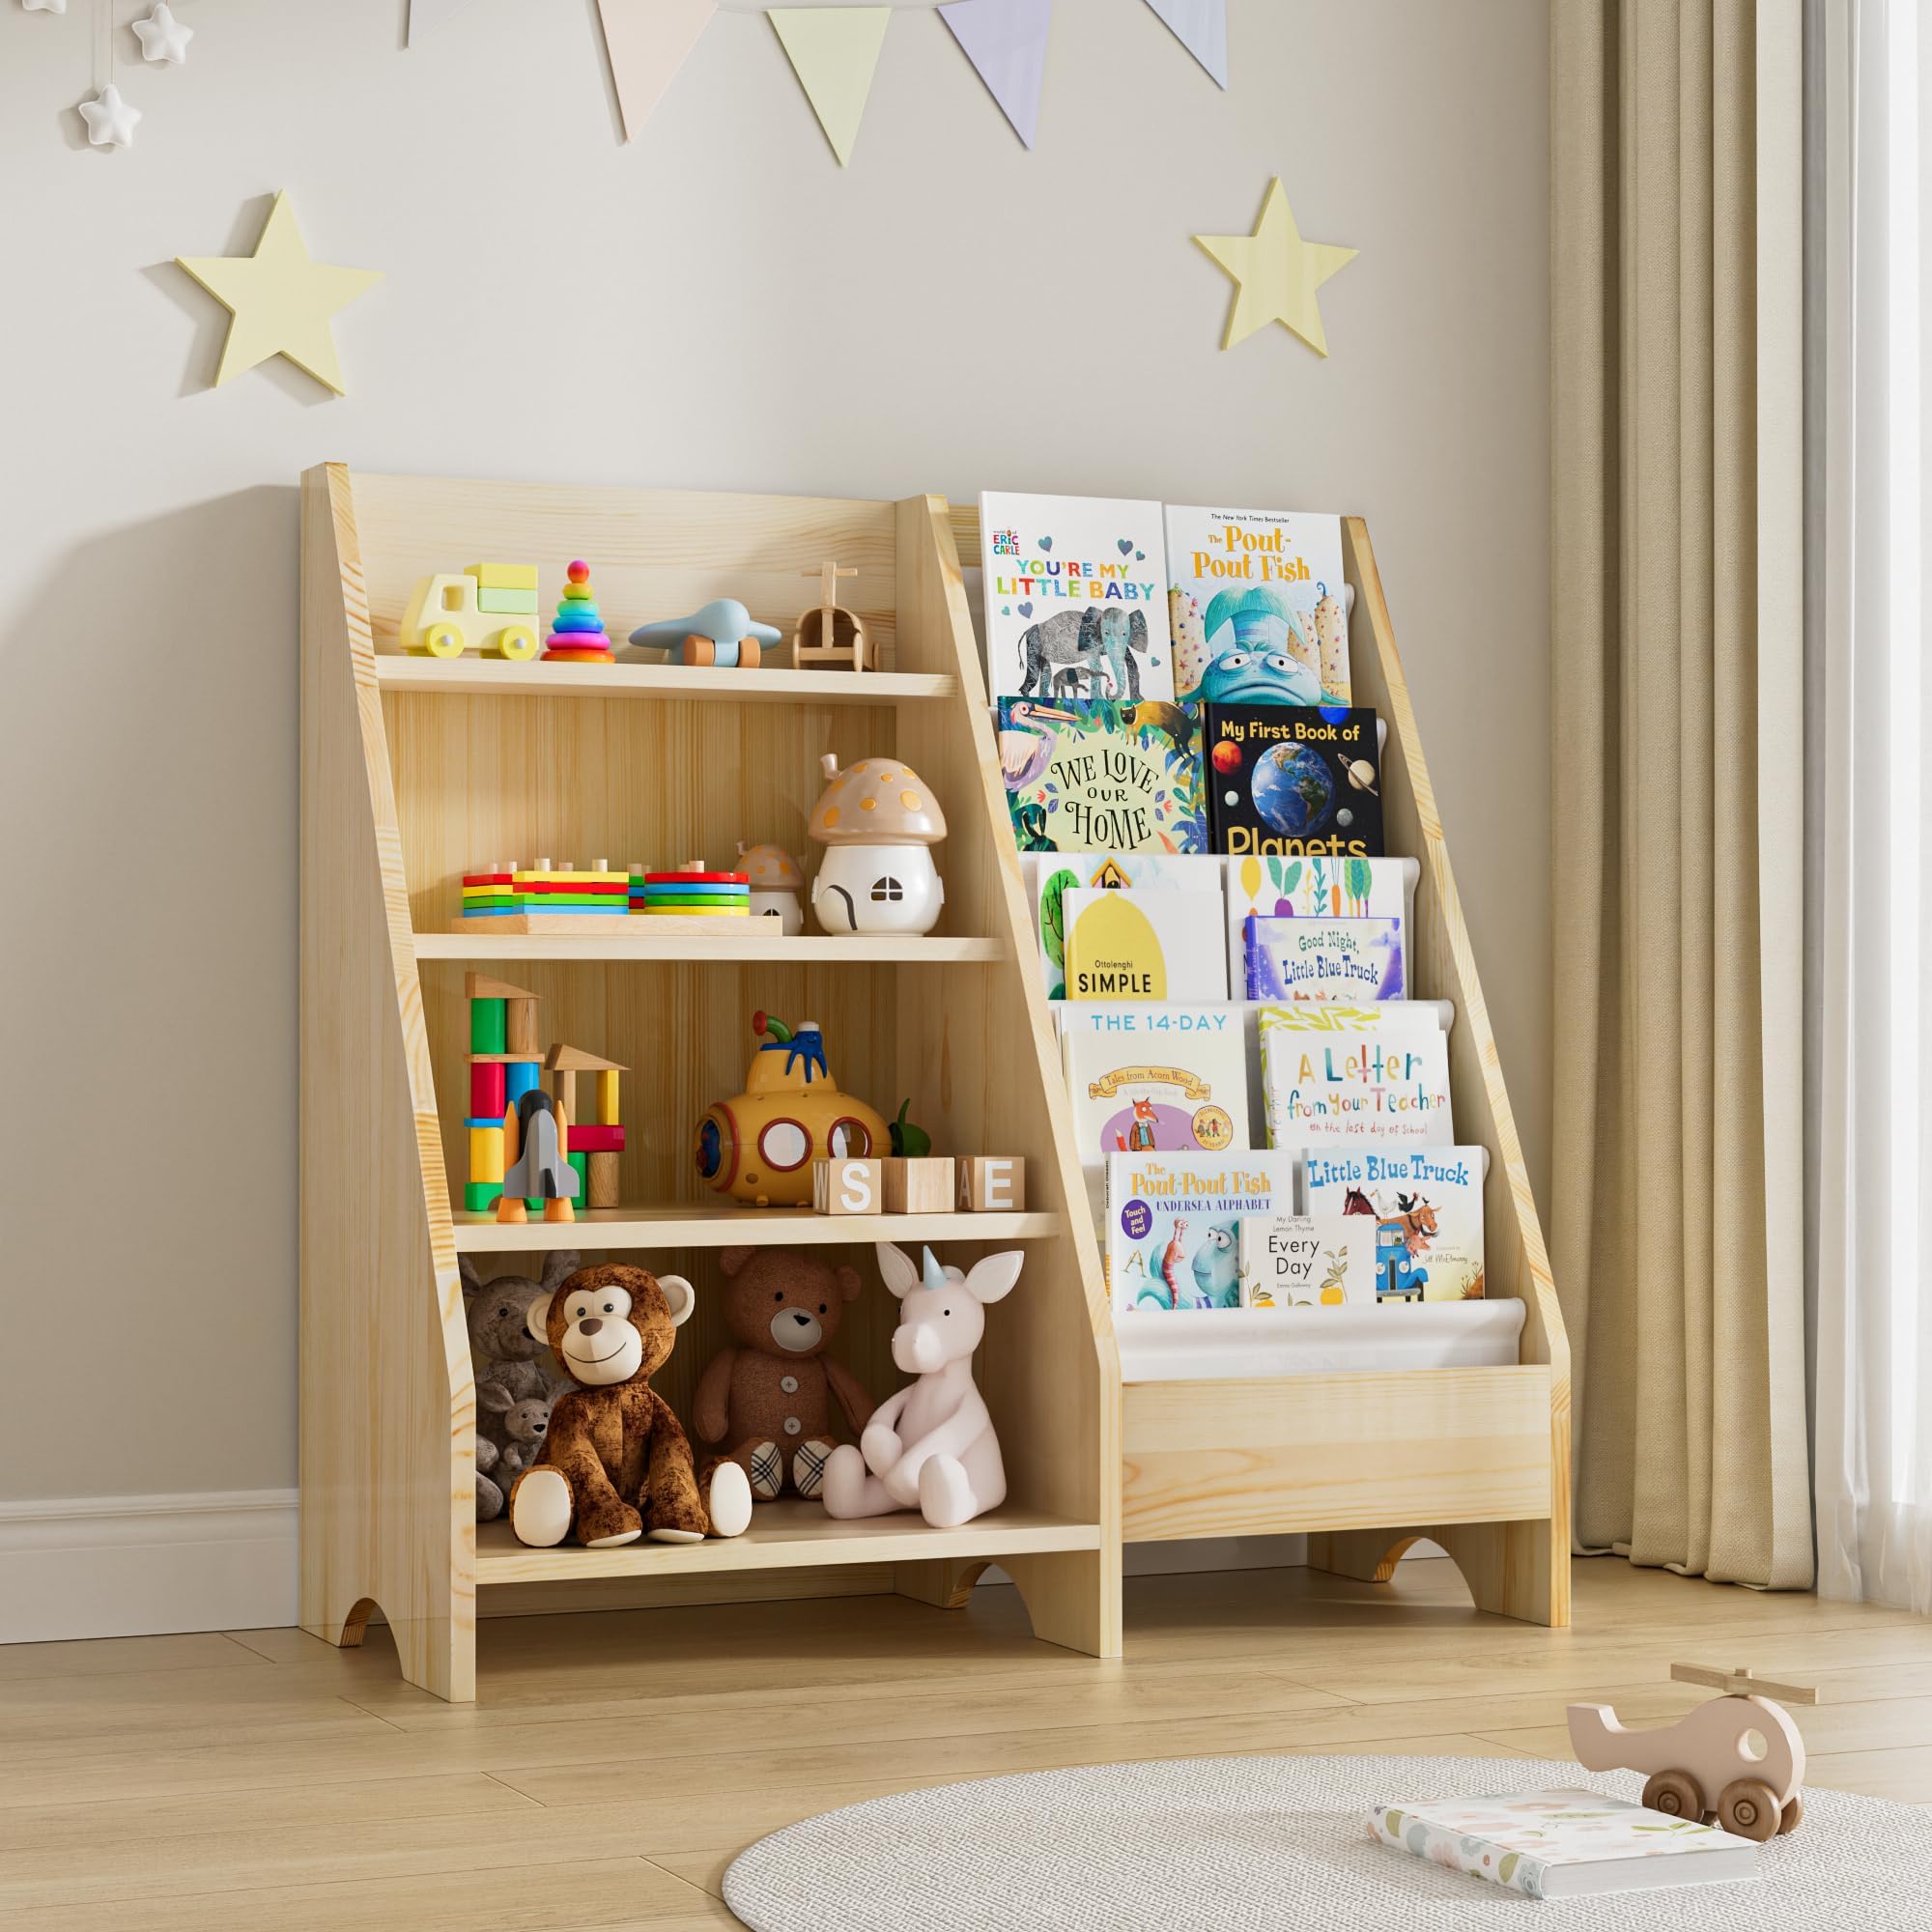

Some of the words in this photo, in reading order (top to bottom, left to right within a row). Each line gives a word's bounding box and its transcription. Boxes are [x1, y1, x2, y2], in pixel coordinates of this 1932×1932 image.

[993, 545, 1020, 555] CARLE
[1208, 534, 1222, 544] The
[1223, 526, 1291, 553] Pout-
[1016, 559, 1094, 578] YOU'RE
[1099, 563, 1128, 579] MY
[1190, 551, 1254, 579] Pout
[1258, 554, 1311, 582] Fish
[997, 577, 1081, 597] LITTLE
[1090, 581, 1155, 601] BABY
[1221, 720, 1244, 742] My
[1249, 722, 1291, 739] First
[1294, 723, 1337, 741] Book
[1342, 724, 1360, 741] of
[1051, 755, 1096, 790] WE
[1101, 750, 1159, 794] LOVE
[1088, 787, 1128, 802] OUR
[1065, 802, 1151, 850] HOME
[1227, 826, 1368, 857] Planets
[1298, 931, 1323, 952] Good
[1327, 931, 1360, 954] Night,
[1094, 960, 1133, 970] Ottolenghi
[1283, 959, 1314, 985] Little
[1316, 954, 1341, 979] Blue
[1343, 954, 1378, 985] Truck
[1078, 974, 1151, 993] SIMPLE
[1091, 1014, 1136, 1031] THE
[1147, 1014, 1227, 1031] 14-DAY
[1298, 1053, 1316, 1084] A
[1325, 1044, 1422, 1083] Letter
[1105, 1073, 1124, 1086] Tales
[1126, 1071, 1144, 1081] from
[1148, 1069, 1169, 1080] Acorn
[1172, 1070, 1194, 1087] Wood
[1287, 1090, 1326, 1120] from
[1370, 1083, 1446, 1113] Teacher
[1324, 1122, 1341, 1133] the
[1346, 1121, 1365, 1133] last
[1370, 1122, 1385, 1137] day
[1389, 1124, 1399, 1135] of
[1146, 1162, 1166, 1176] The
[1308, 1159, 1361, 1188] Little
[1366, 1155, 1408, 1180] Blue
[1410, 1155, 1468, 1185] Truck
[813, 1161, 828, 1211] W
[840, 1162, 871, 1211] S
[958, 1160, 972, 1208] A
[985, 1160, 1012, 1208] E
[1128, 1172, 1228, 1196] Pout-Pout
[1231, 1171, 1271, 1195] Fish
[1124, 1206, 1146, 1219] Touch
[1156, 1200, 1211, 1212] UNDERSEA
[1216, 1199, 1271, 1210] ALPHABET
[1130, 1217, 1144, 1226] and
[1131, 1225, 1146, 1235] Feel
[1294, 1225, 1314, 1234] Thyme
[1269, 1236, 1320, 1258] Every
[1277, 1257, 1312, 1280] Day
